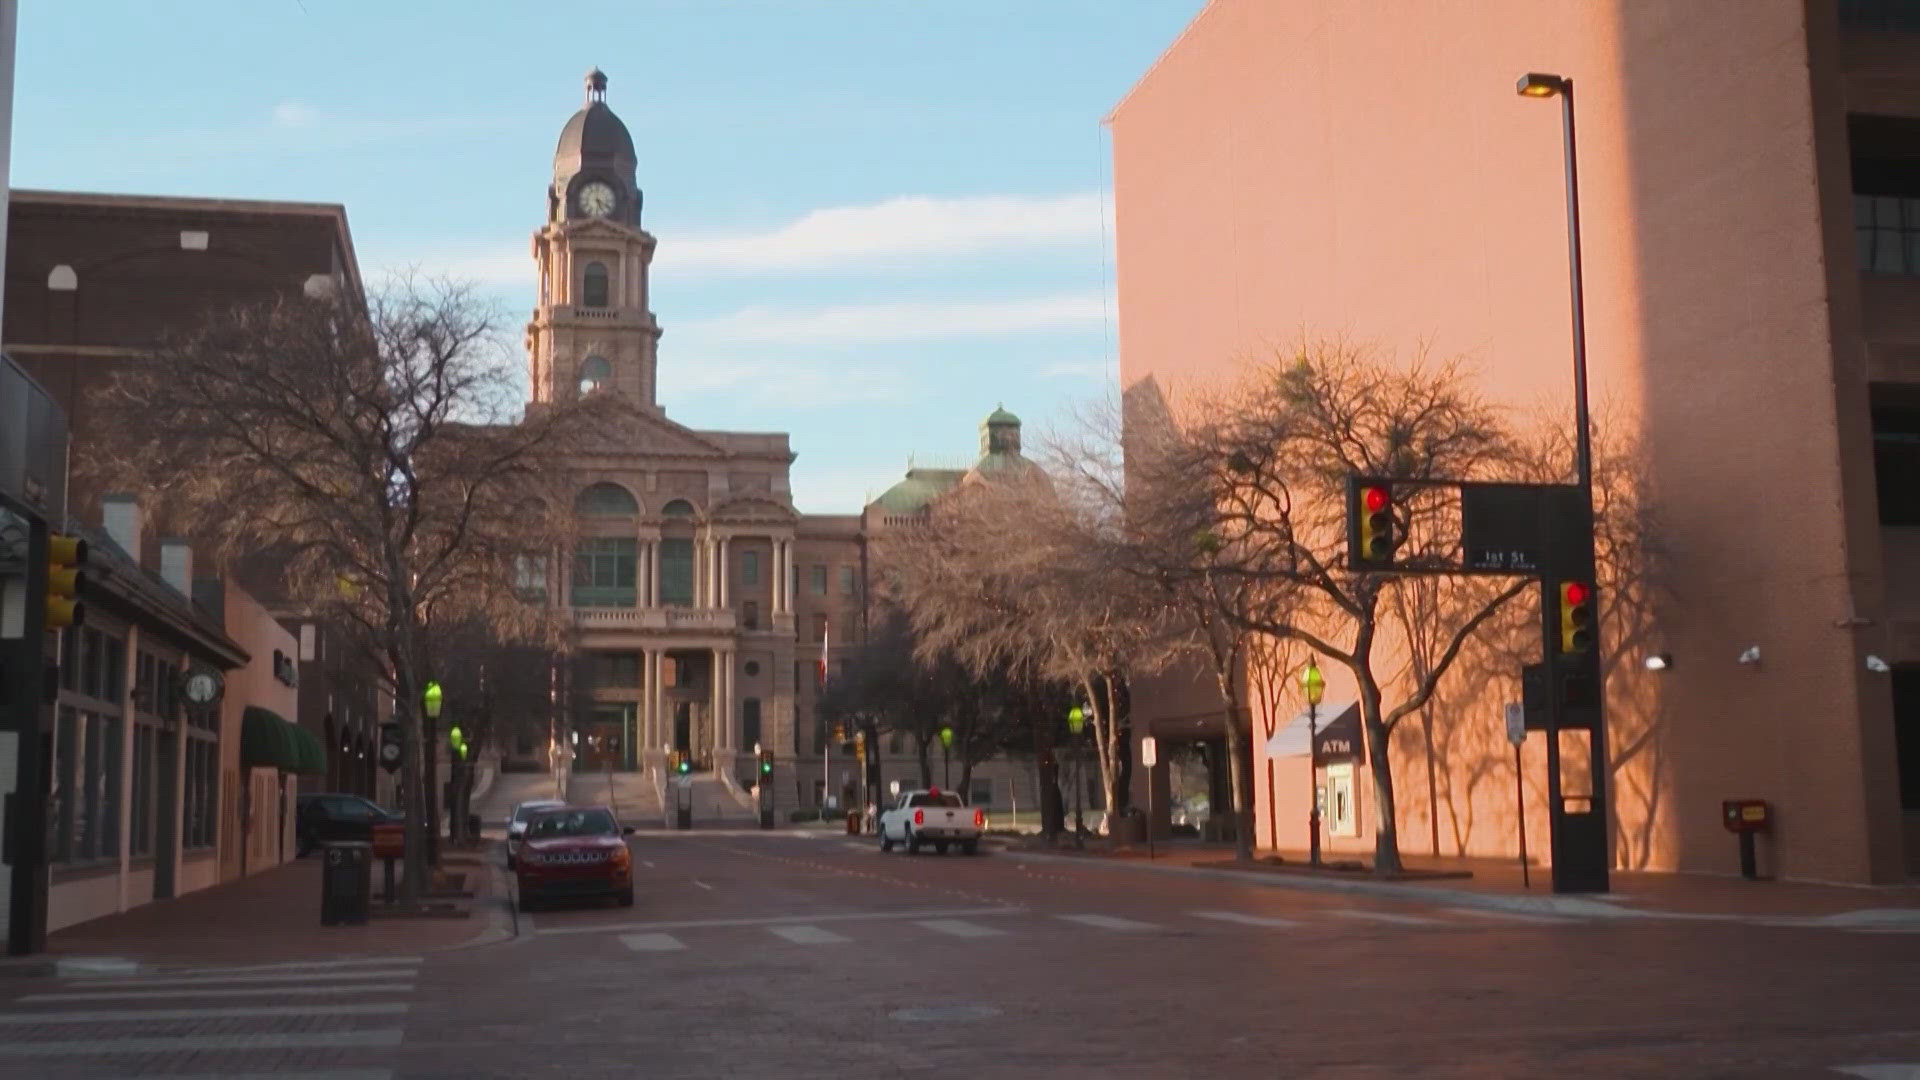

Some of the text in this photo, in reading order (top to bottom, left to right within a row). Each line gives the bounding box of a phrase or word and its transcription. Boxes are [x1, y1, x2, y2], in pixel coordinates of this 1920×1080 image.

[1485, 550, 1525, 562] 1st St
[1321, 740, 1351, 753] ATM
